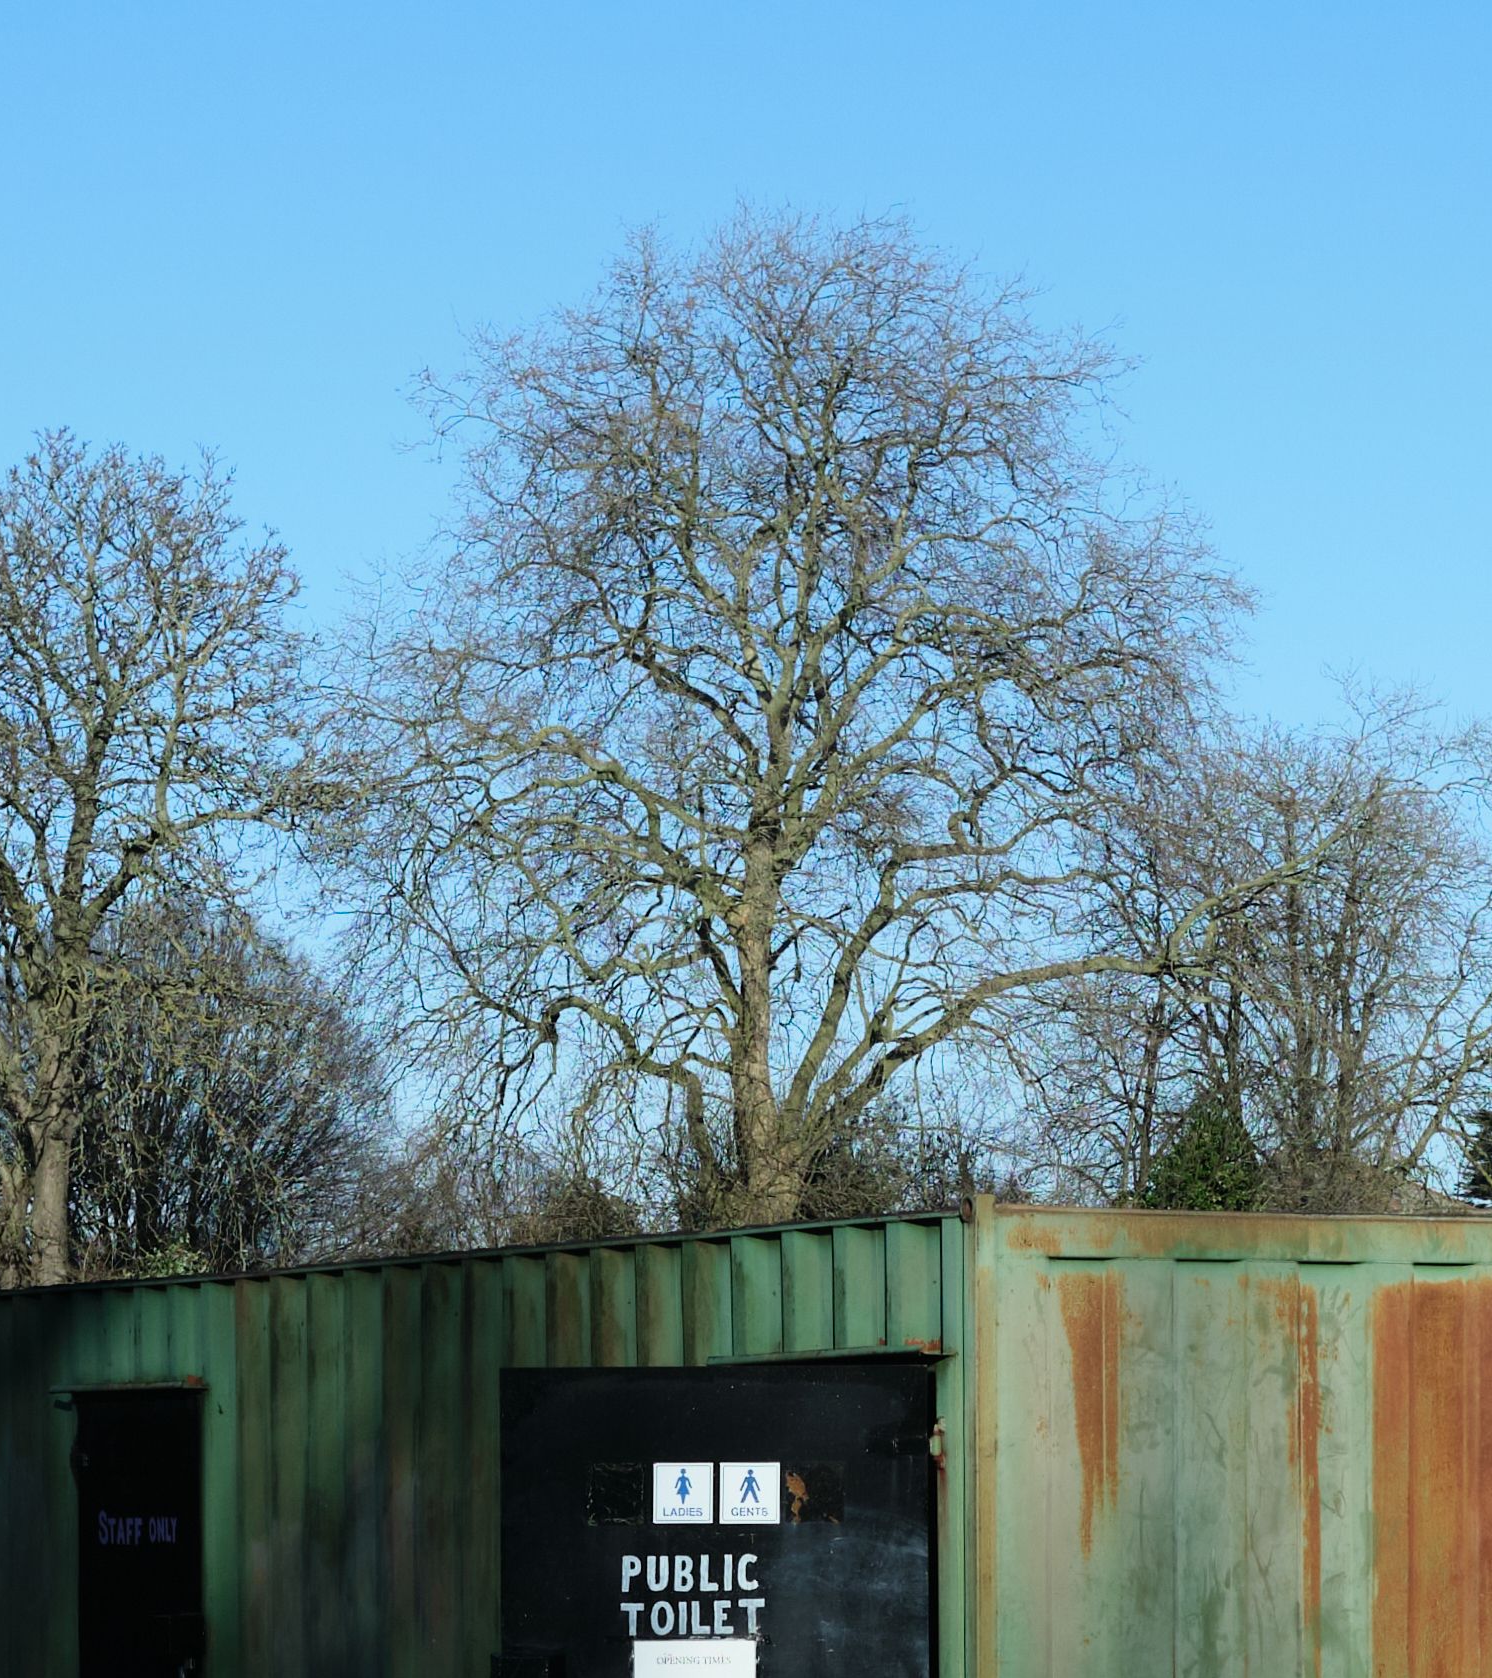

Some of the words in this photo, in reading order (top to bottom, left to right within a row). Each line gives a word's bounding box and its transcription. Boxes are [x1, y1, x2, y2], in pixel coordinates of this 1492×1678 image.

[663, 1507, 703, 1517] LADIES
[731, 1507, 769, 1517] GENTS
[98, 1508, 143, 1545] STAFF
[148, 1516, 178, 1544] ONLY
[620, 1553, 760, 1593] PUBLIC
[620, 1597, 766, 1637] TOILET
[656, 1655, 700, 1665] OPENING
[702, 1655, 732, 1665] TIMES
